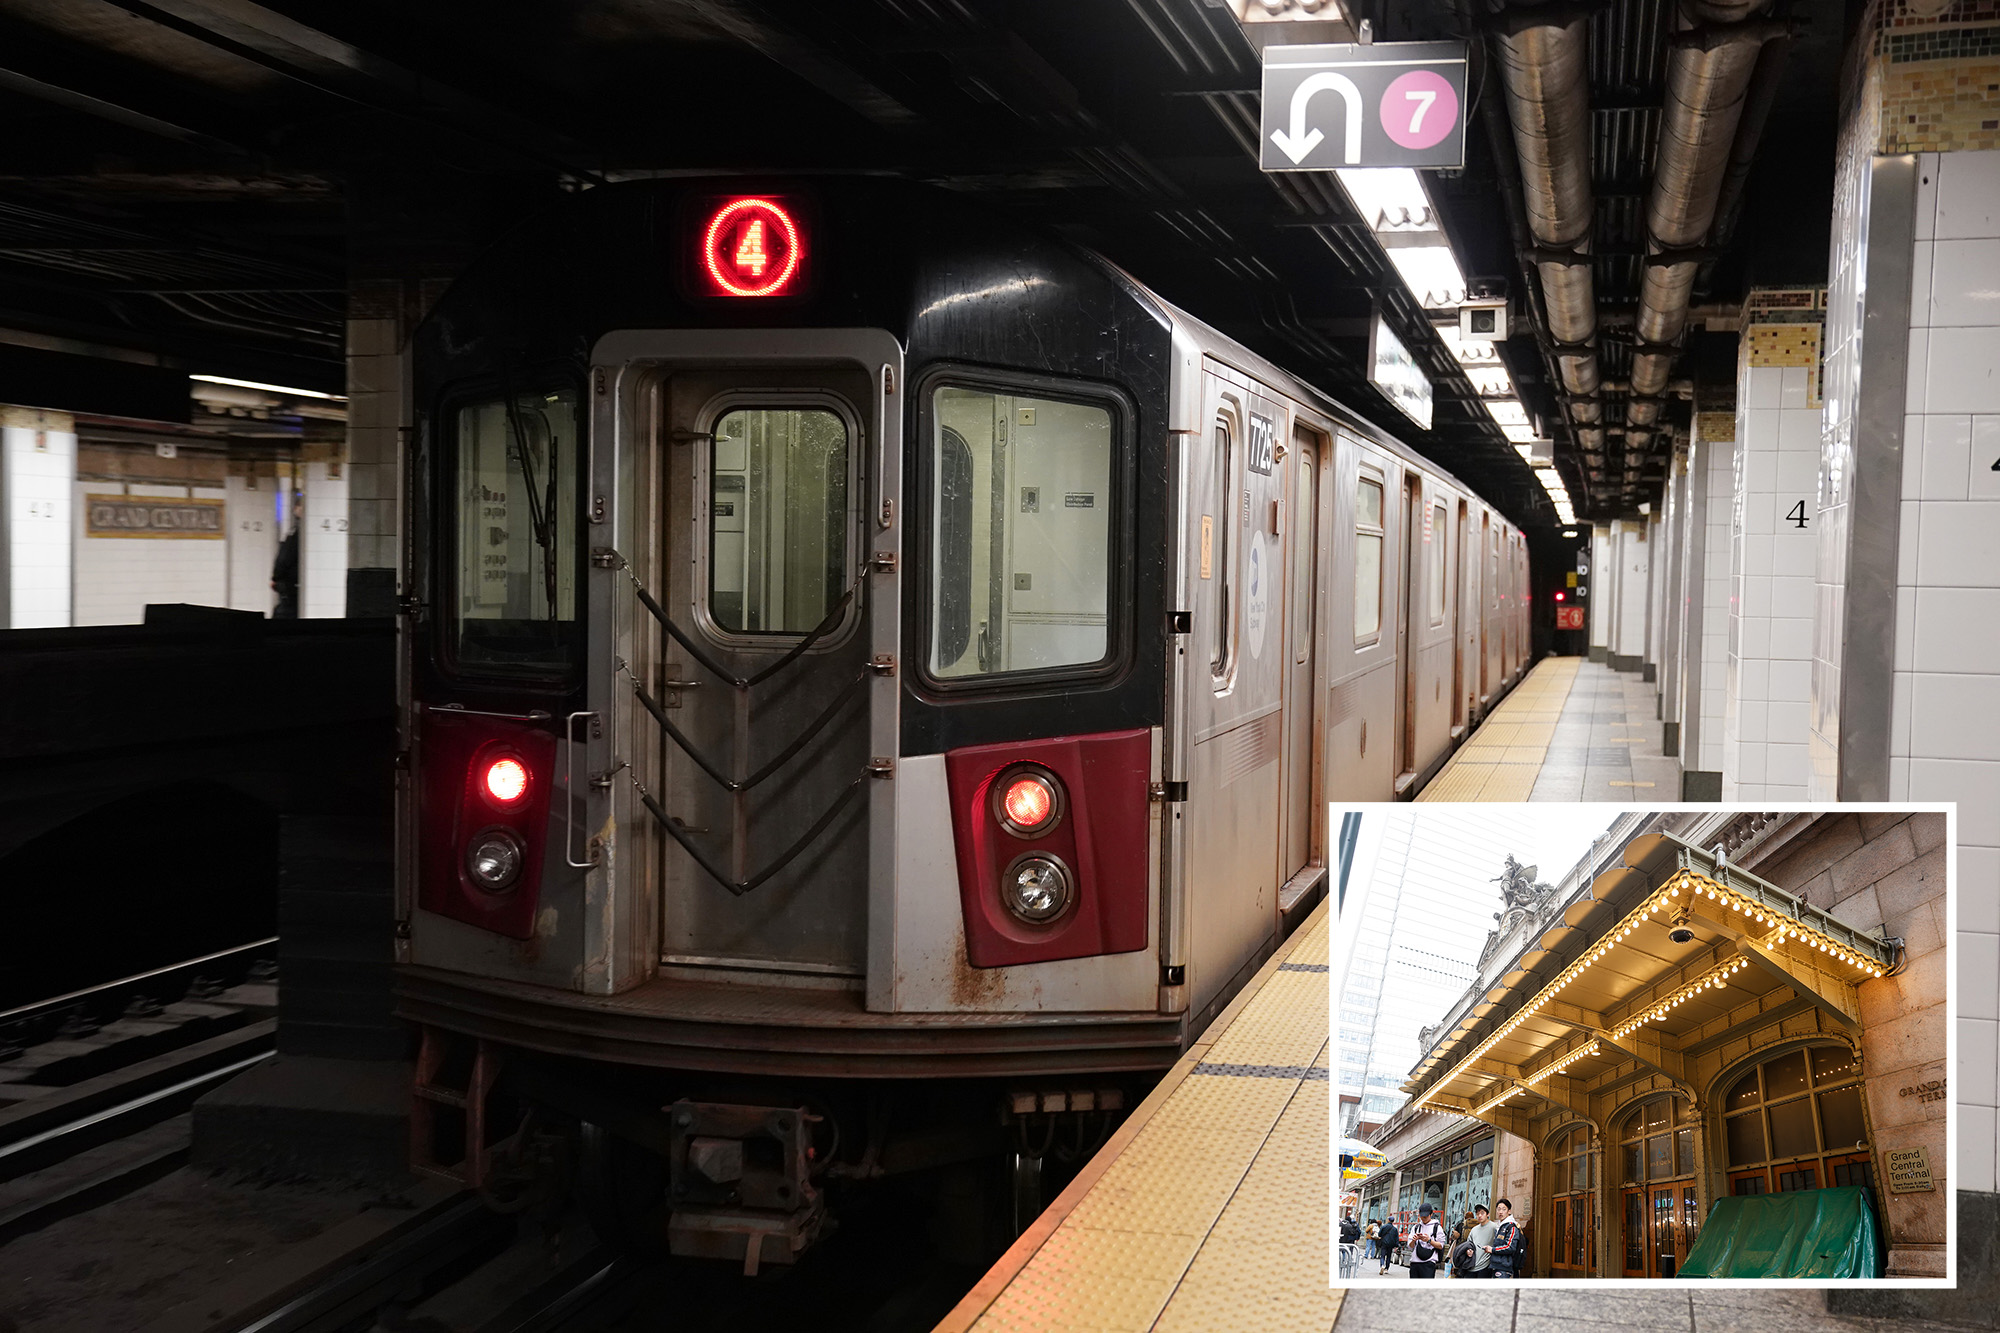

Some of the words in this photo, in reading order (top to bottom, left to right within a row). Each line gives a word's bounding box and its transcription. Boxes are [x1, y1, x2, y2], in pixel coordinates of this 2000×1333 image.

[1405, 91, 1436, 133] 7
[736, 220, 767, 276] 4
[1250, 416, 1273, 471] 7725
[1785, 500, 1810, 528] 4
[1577, 565, 1588, 576] 10
[1576, 586, 1587, 597] 10
[1899, 1080, 1940, 1097] GRAND
[1890, 1150, 1920, 1161] Grand
[1890, 1159, 1925, 1171] Central
[1890, 1169, 1930, 1180] Terminal
